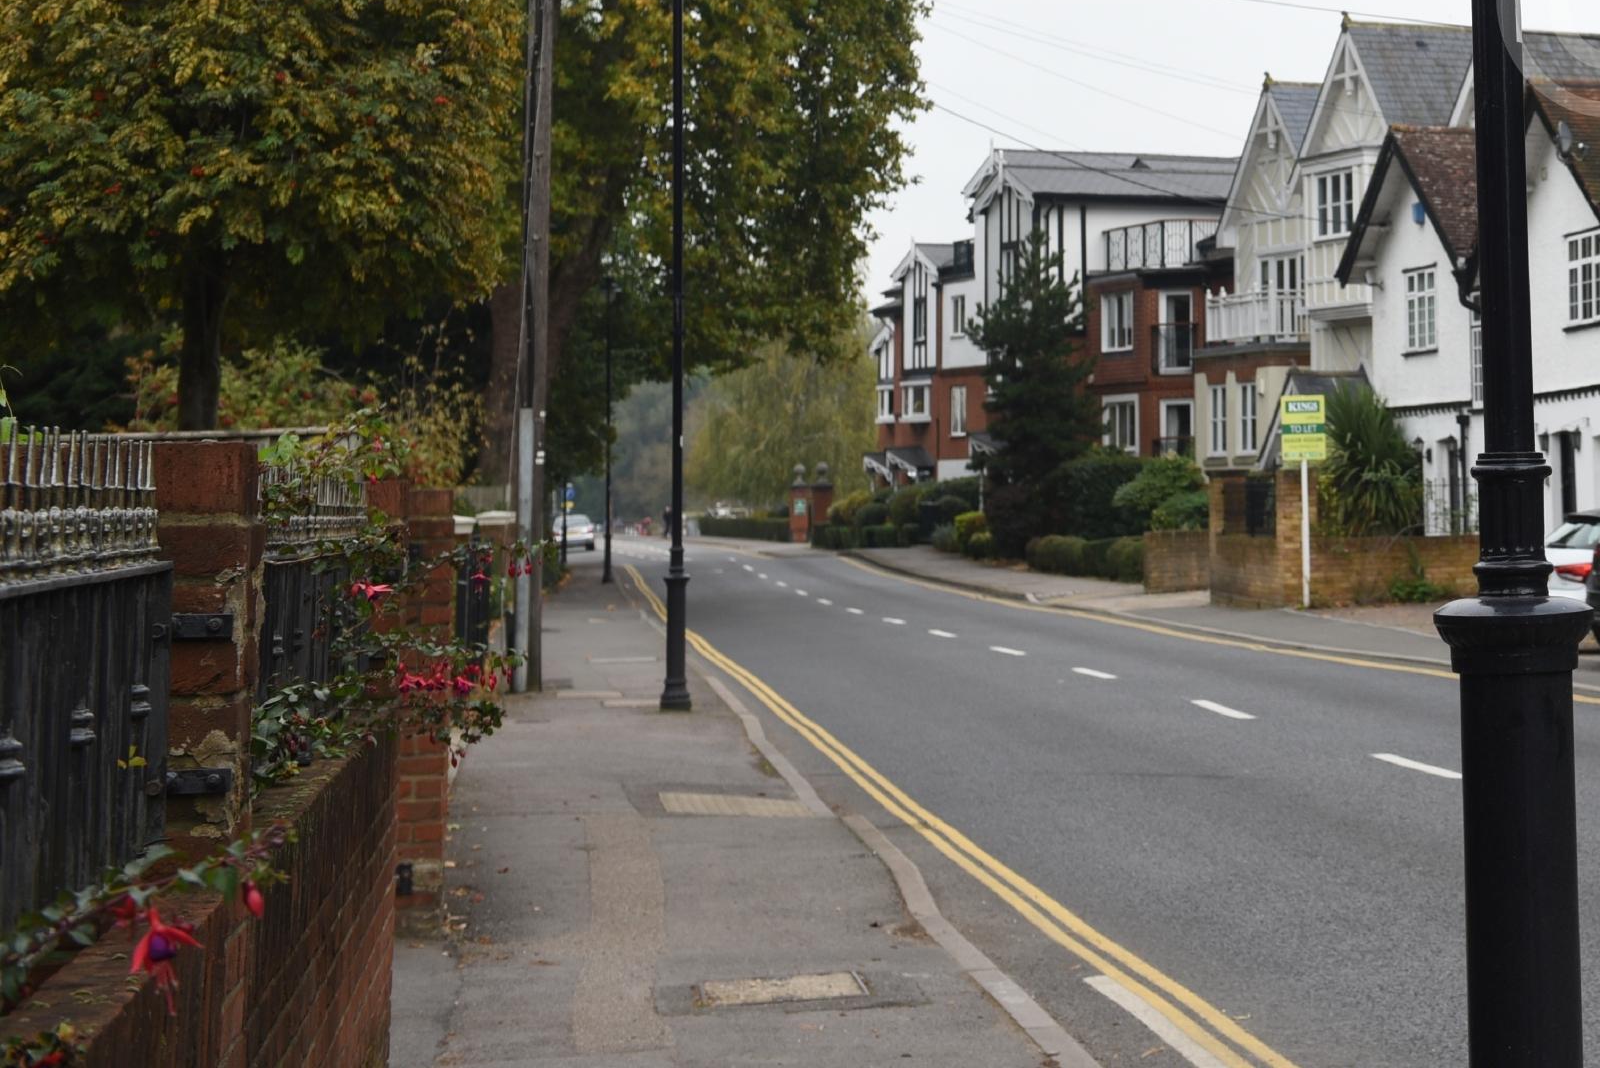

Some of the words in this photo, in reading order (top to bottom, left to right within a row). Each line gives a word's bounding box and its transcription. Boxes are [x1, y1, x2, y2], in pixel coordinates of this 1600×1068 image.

[1287, 401, 1318, 412] KINGS
[1290, 424, 1301, 433] TO
[1303, 424, 1317, 433] LET
